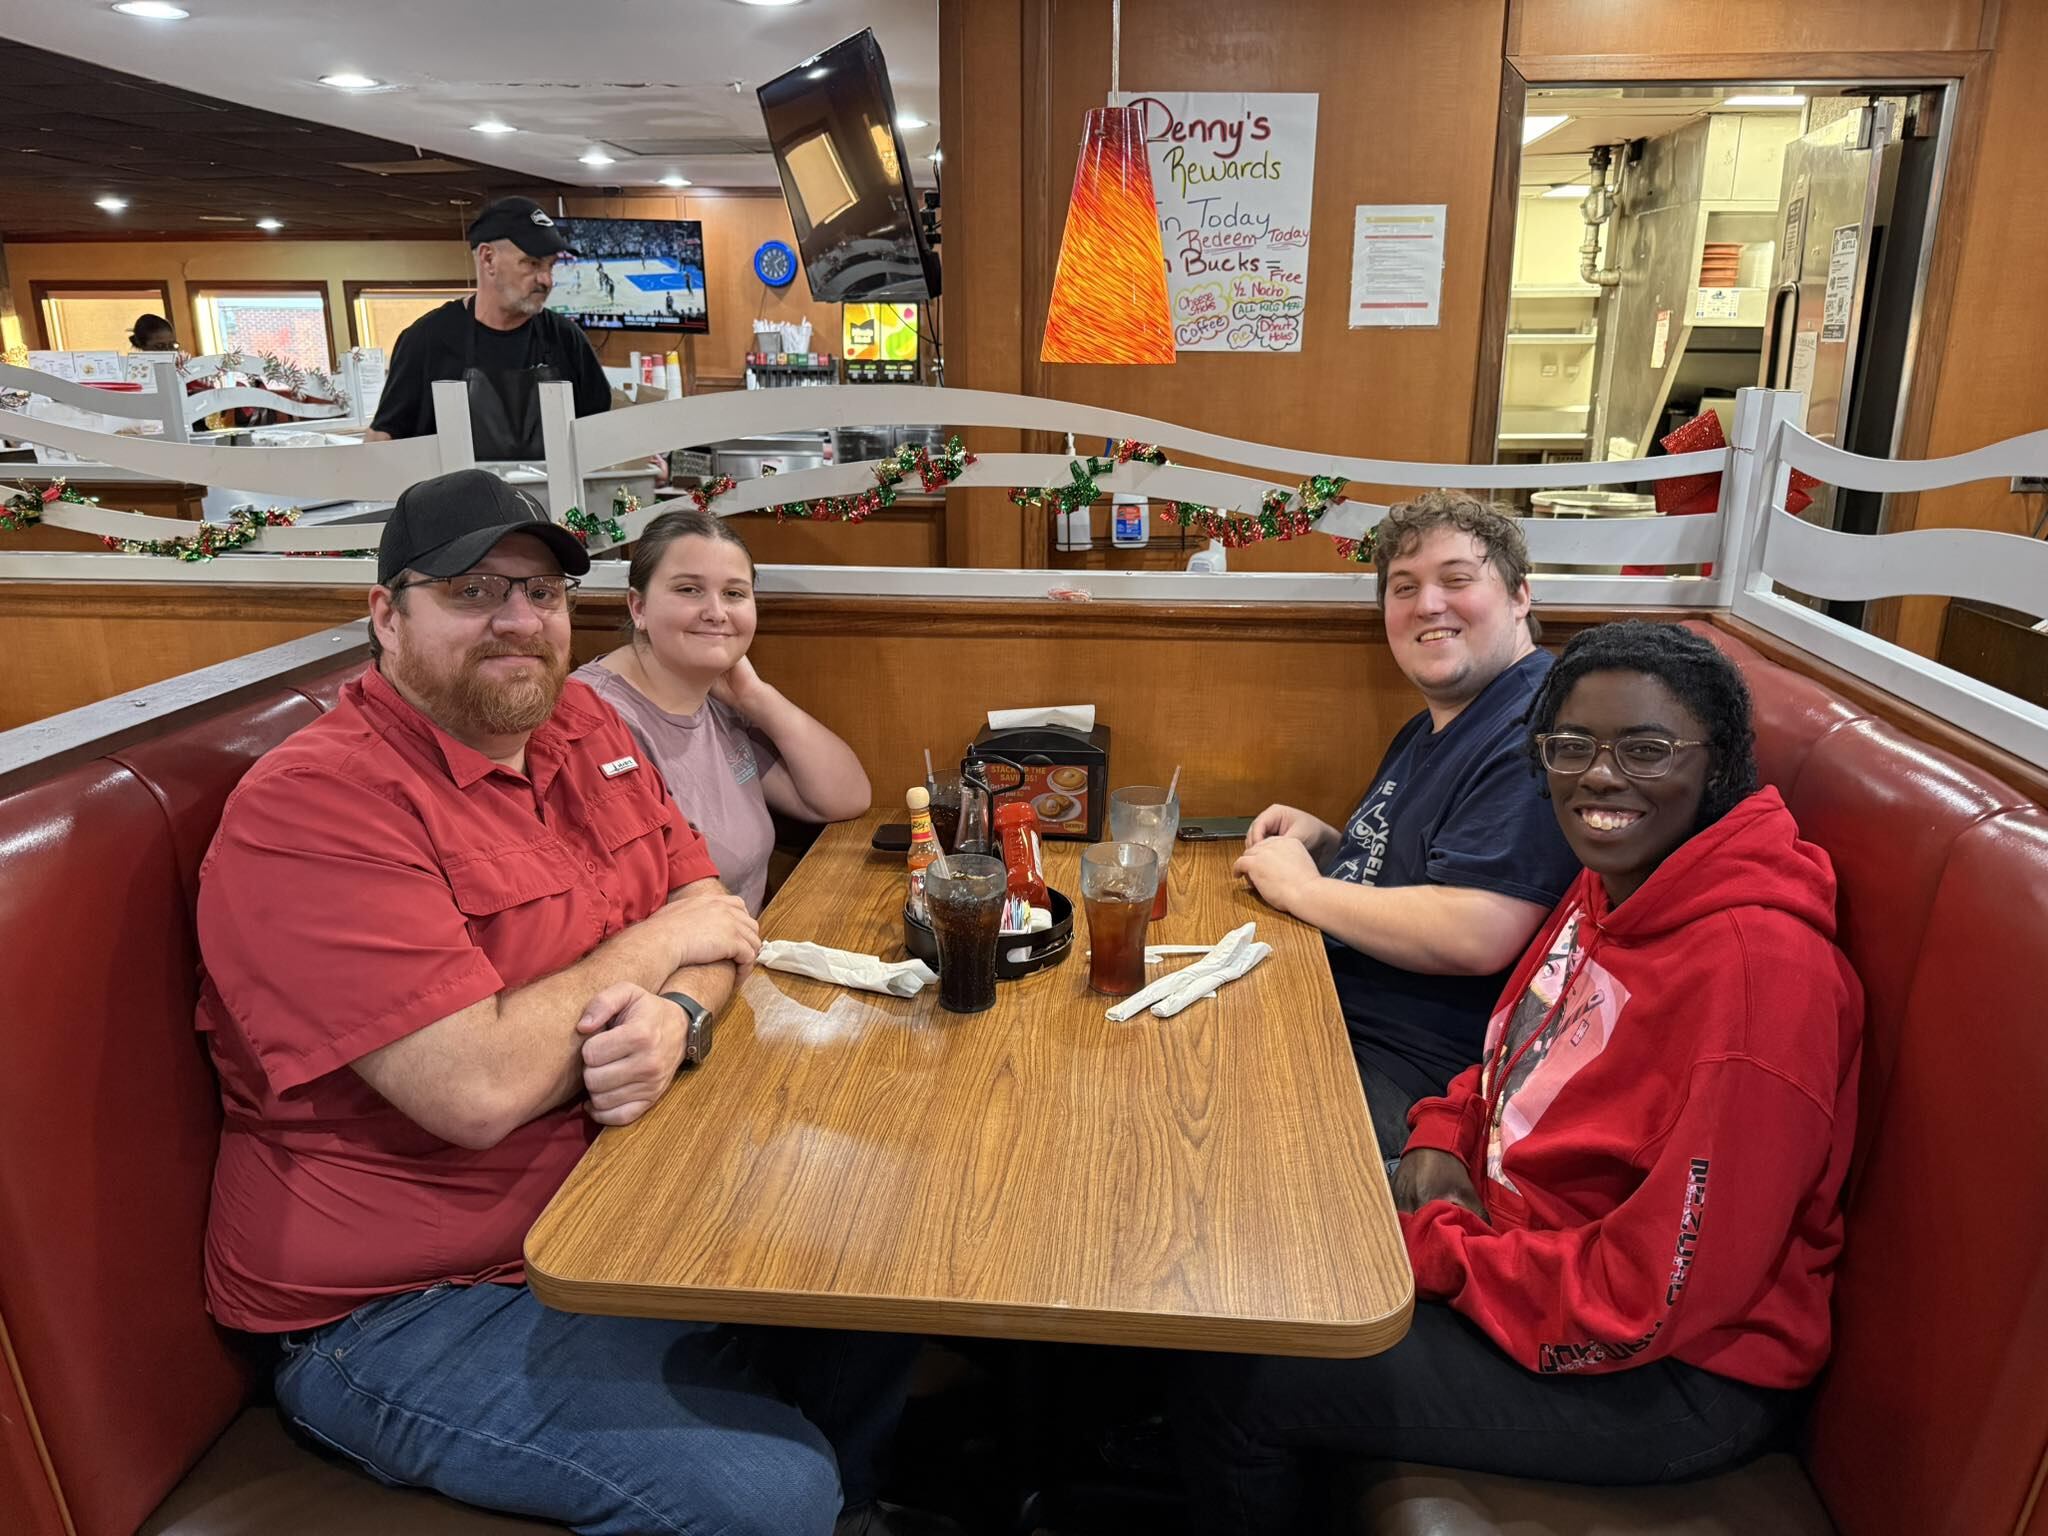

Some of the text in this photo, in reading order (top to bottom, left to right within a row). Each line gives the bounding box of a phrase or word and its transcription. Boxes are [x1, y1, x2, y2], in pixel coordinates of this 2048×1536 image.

[1128, 97, 1271, 159] Denny's
[1163, 145, 1282, 199] Rewards
[1187, 197, 1270, 238] Today
[1177, 226, 1310, 251] Redeem Today
[1180, 249, 1261, 276] Bucks
[1252, 281, 1284, 297] Nacho
[1269, 269, 1304, 284] Free
[1238, 305, 1256, 315] ALL
[1180, 317, 1225, 344] Coffee
[1260, 319, 1293, 332] Donut
[1000, 774, 1038, 782] SAVIGS!
